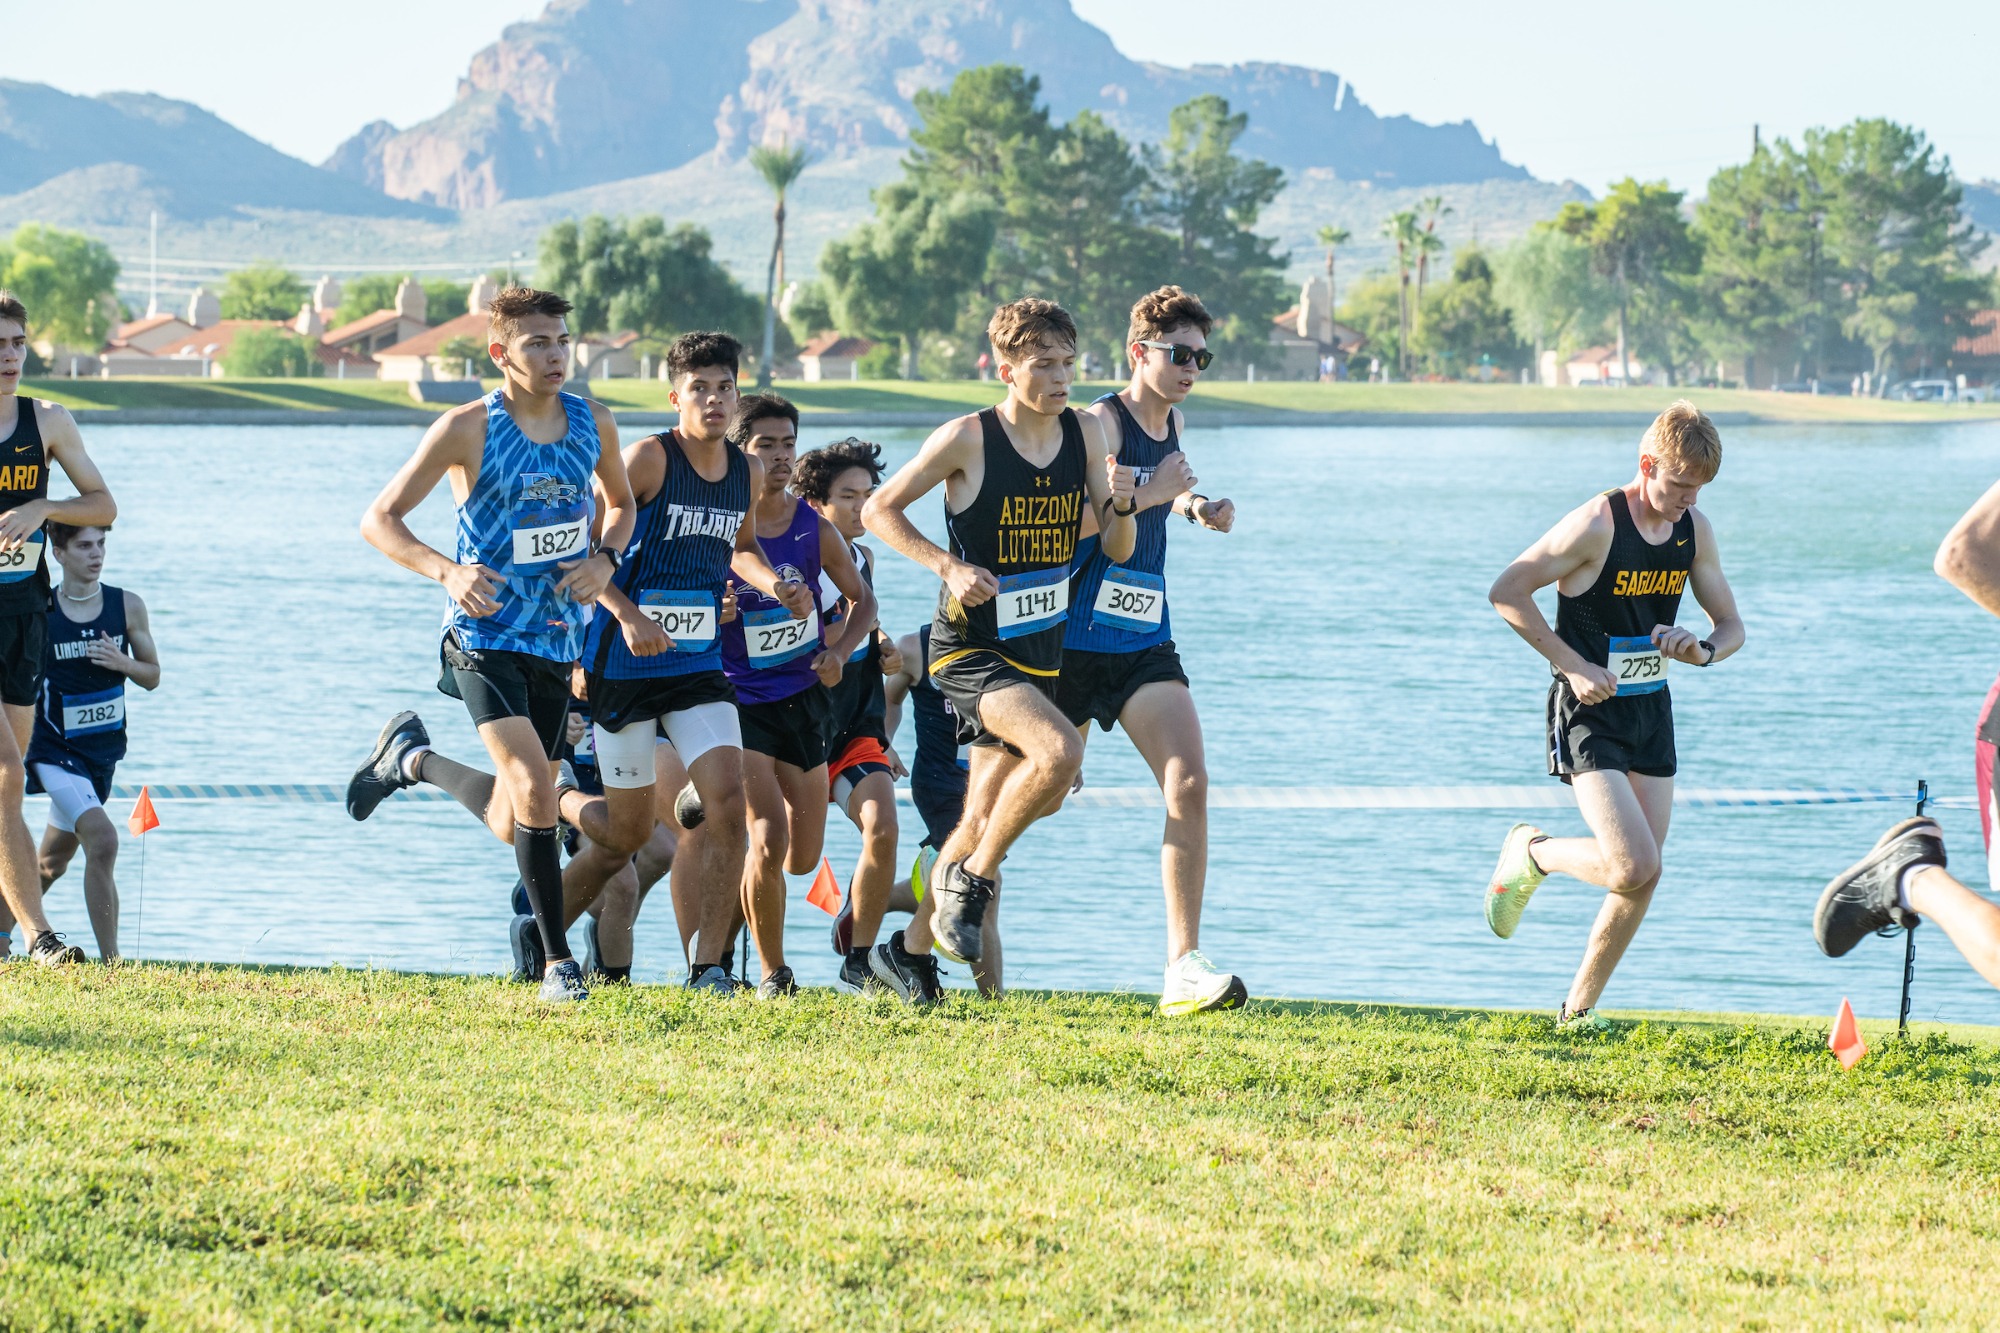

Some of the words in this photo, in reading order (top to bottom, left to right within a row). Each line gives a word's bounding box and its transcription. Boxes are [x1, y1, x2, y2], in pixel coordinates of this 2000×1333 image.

[707, 507, 738, 516] CHRISTIAN
[531, 527, 580, 557] 1827
[1613, 570, 1688, 597] SAGUARO
[1015, 590, 1056, 618] 1141
[1108, 588, 1155, 614] 3057
[758, 619, 808, 652] 2737
[54, 641, 89, 660] LINCO
[1620, 655, 1661, 679] 2753
[77, 704, 116, 725] 2182
